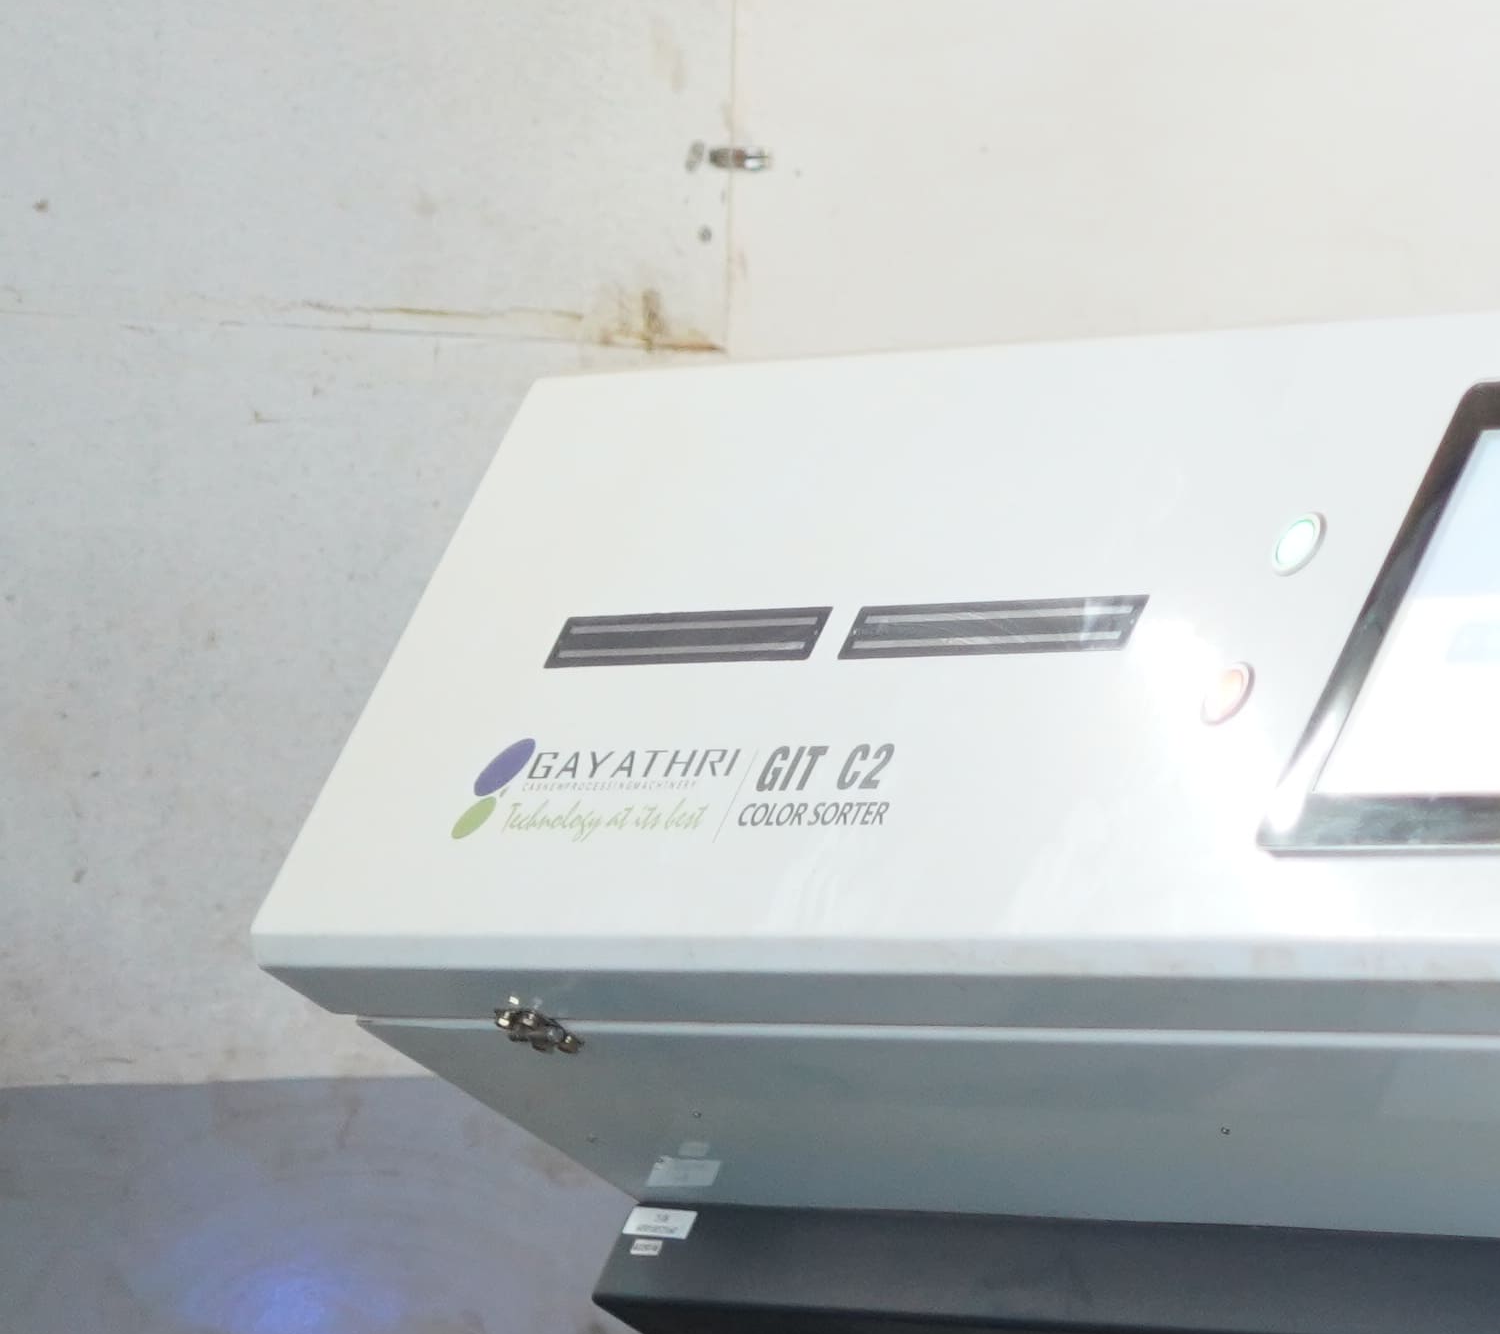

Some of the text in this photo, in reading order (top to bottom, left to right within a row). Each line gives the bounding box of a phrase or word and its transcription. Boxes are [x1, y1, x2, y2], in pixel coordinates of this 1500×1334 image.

[527, 748, 741, 780] GAYATHRI
[755, 743, 896, 792] GIT C2
[502, 797, 710, 843] Technology at its best
[737, 801, 891, 827] COLOR SORTER
